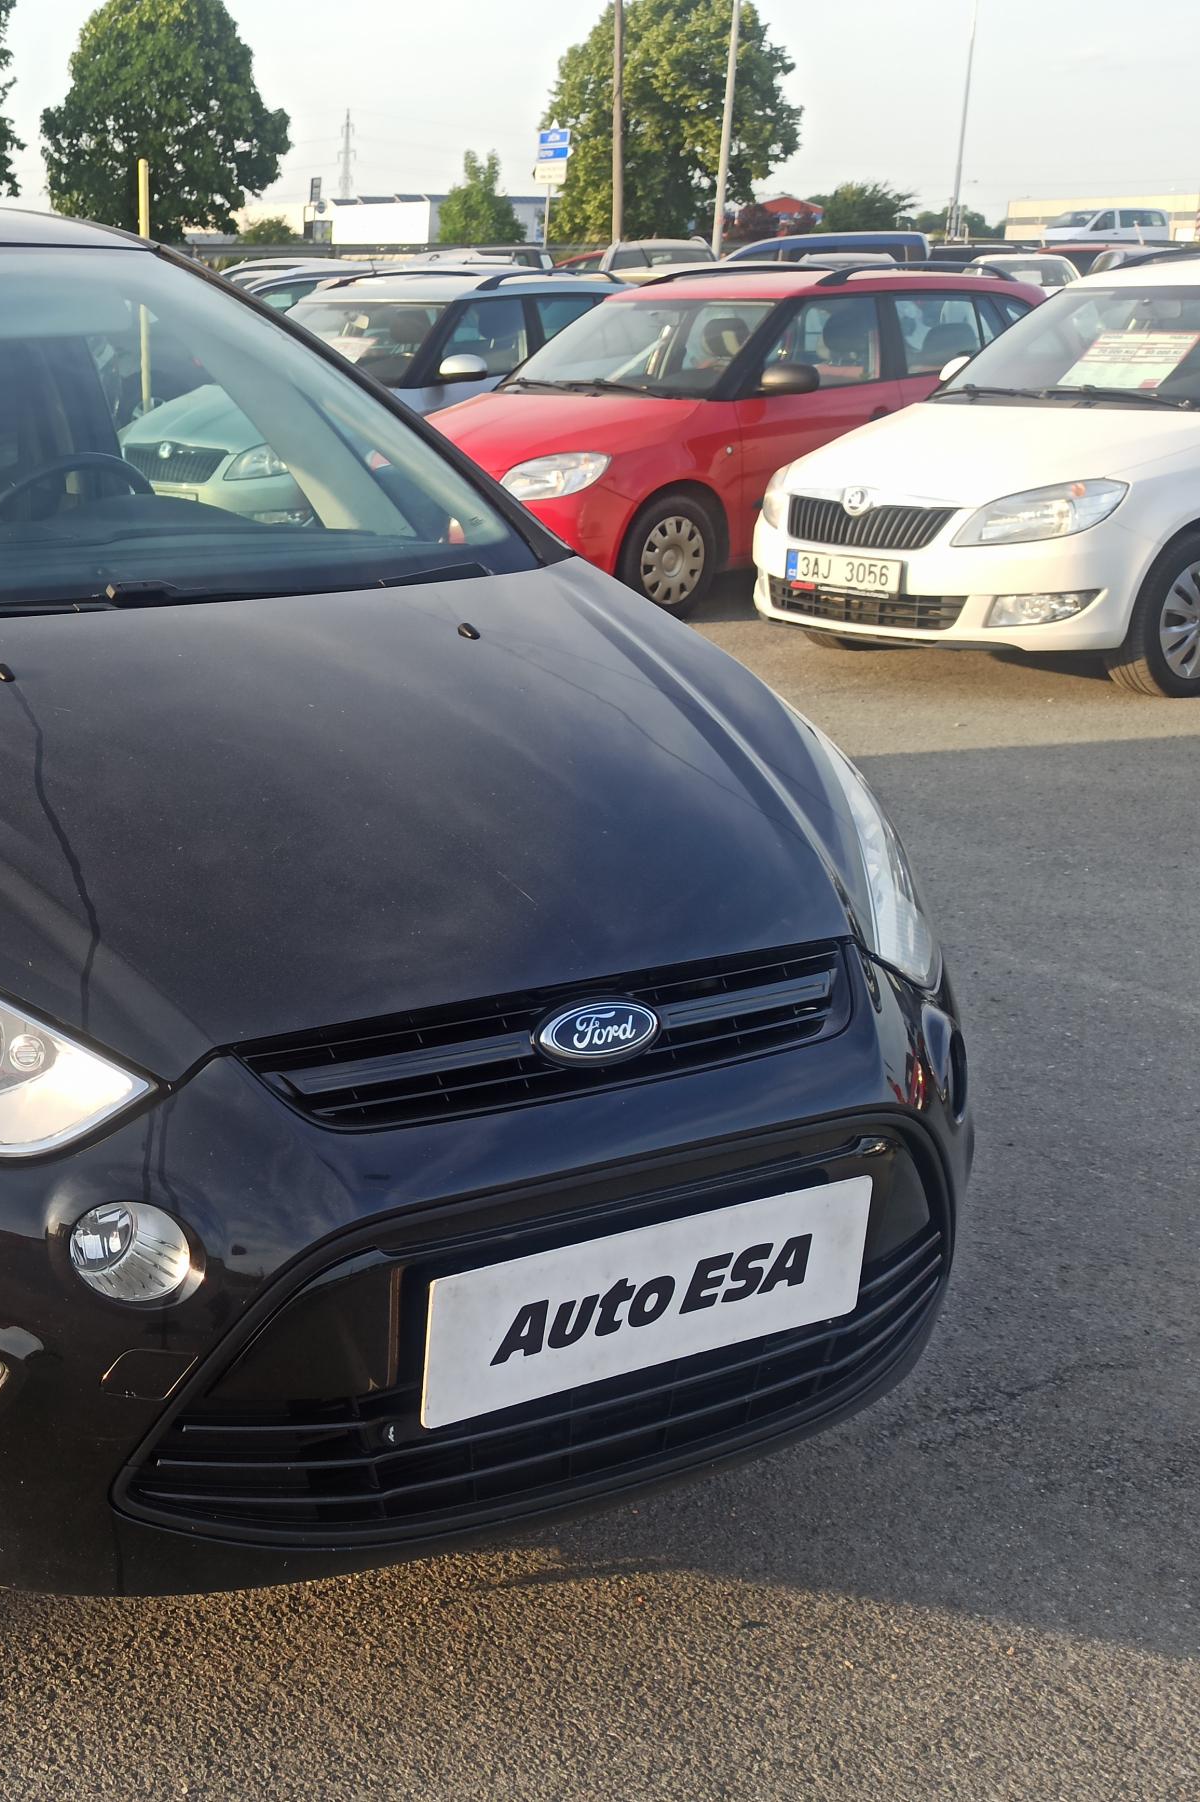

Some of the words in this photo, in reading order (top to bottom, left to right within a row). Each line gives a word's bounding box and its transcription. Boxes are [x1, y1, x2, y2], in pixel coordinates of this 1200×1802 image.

[801, 556, 832, 579] 3AJ
[845, 561, 889, 586] 3056
[573, 1011, 636, 1049] Ford
[490, 1275, 675, 1366] Auto
[679, 1233, 812, 1314] ESA
